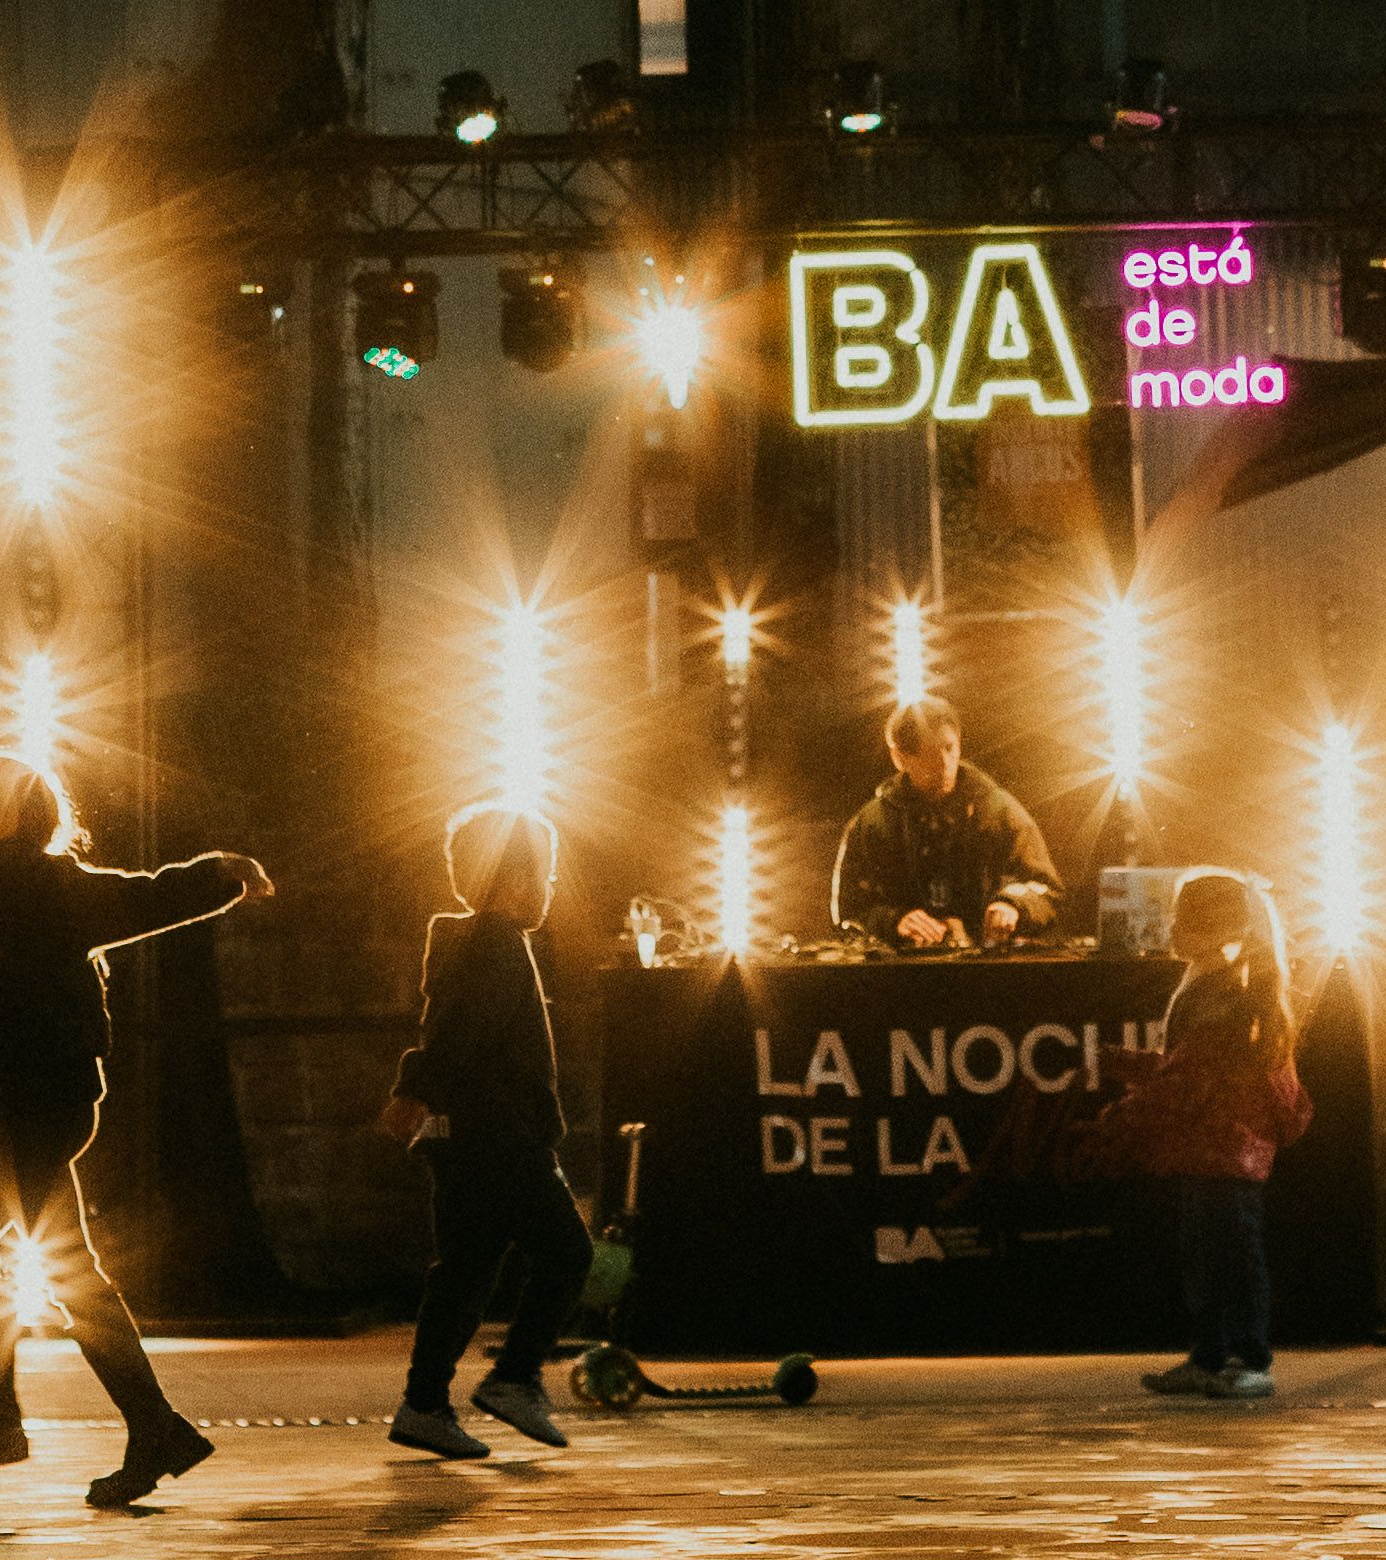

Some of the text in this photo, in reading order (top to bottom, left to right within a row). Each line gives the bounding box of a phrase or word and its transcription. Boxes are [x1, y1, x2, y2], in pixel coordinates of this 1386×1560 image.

[1124, 236, 1253, 288] está
[790, 243, 1091, 427] BA
[1126, 299, 1196, 348] de
[1131, 356, 1285, 409] moda
[755, 1028, 862, 1097] LA
[760, 1115, 854, 1175] DE
[876, 1116, 972, 1176] LA
